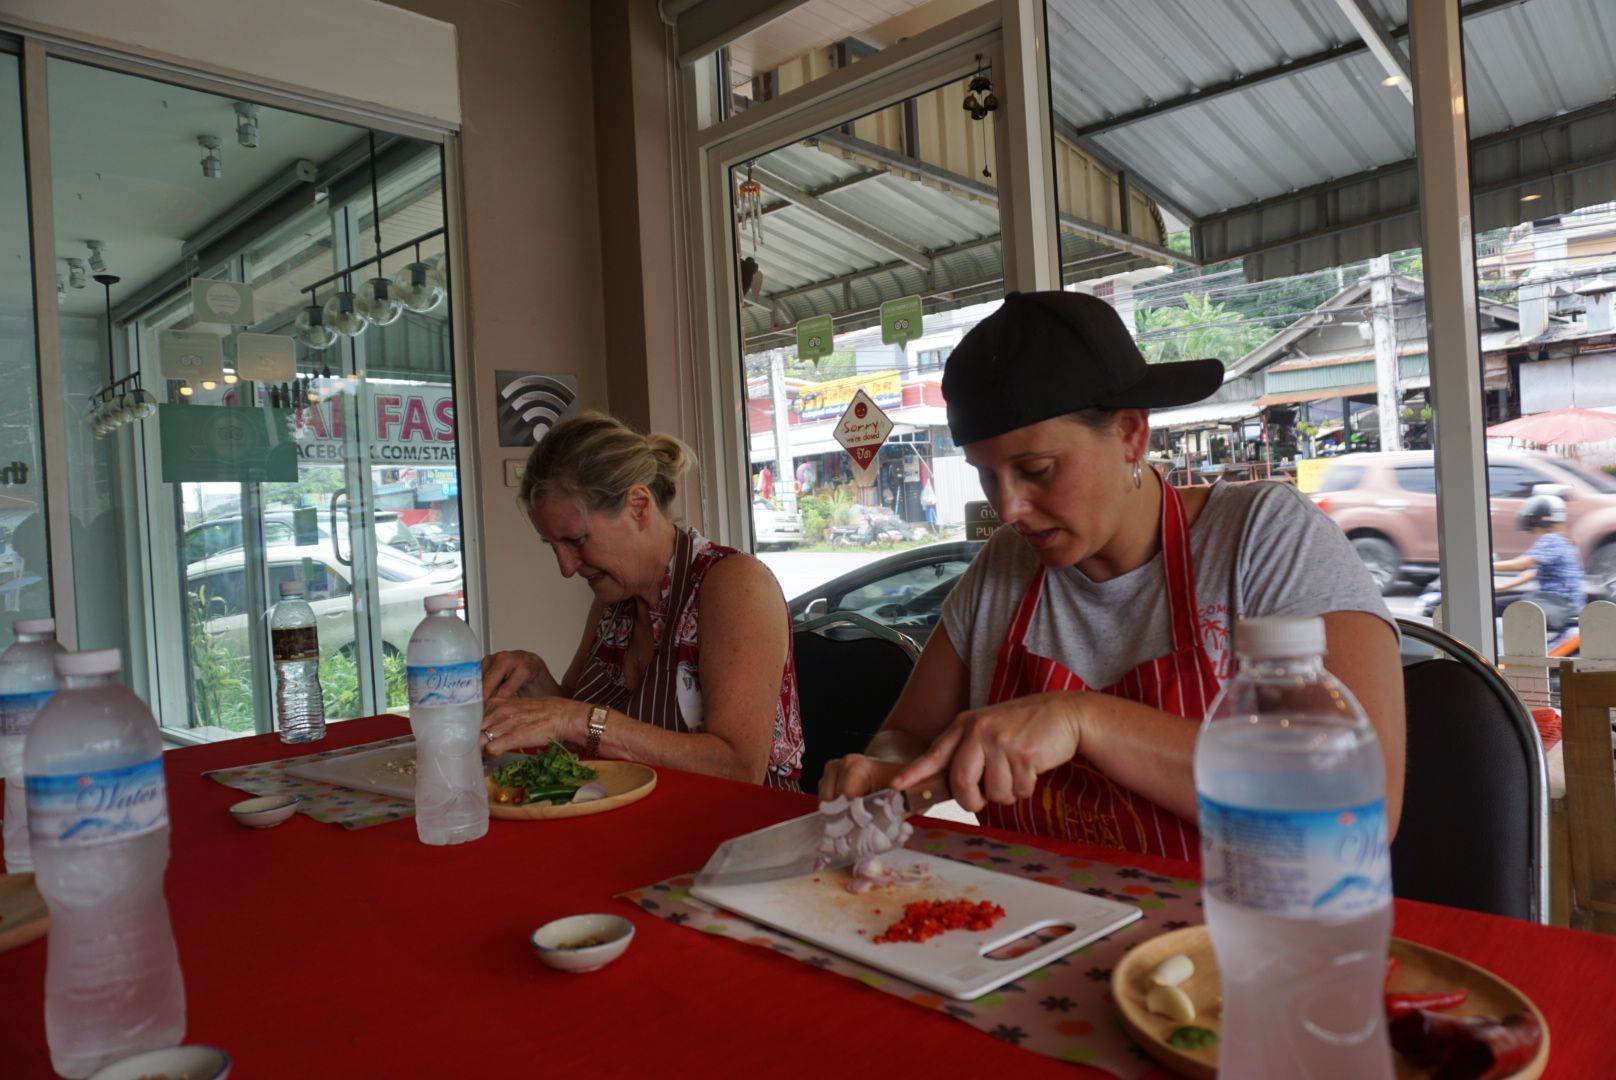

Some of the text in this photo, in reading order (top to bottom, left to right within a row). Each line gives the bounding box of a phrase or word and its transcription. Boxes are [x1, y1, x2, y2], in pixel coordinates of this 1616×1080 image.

[843, 420, 879, 434] Sorry
[862, 430, 880, 440] closed
[856, 447, 871, 460] ปิด
[427, 671, 473, 690] Water
[75, 780, 158, 813] Water
